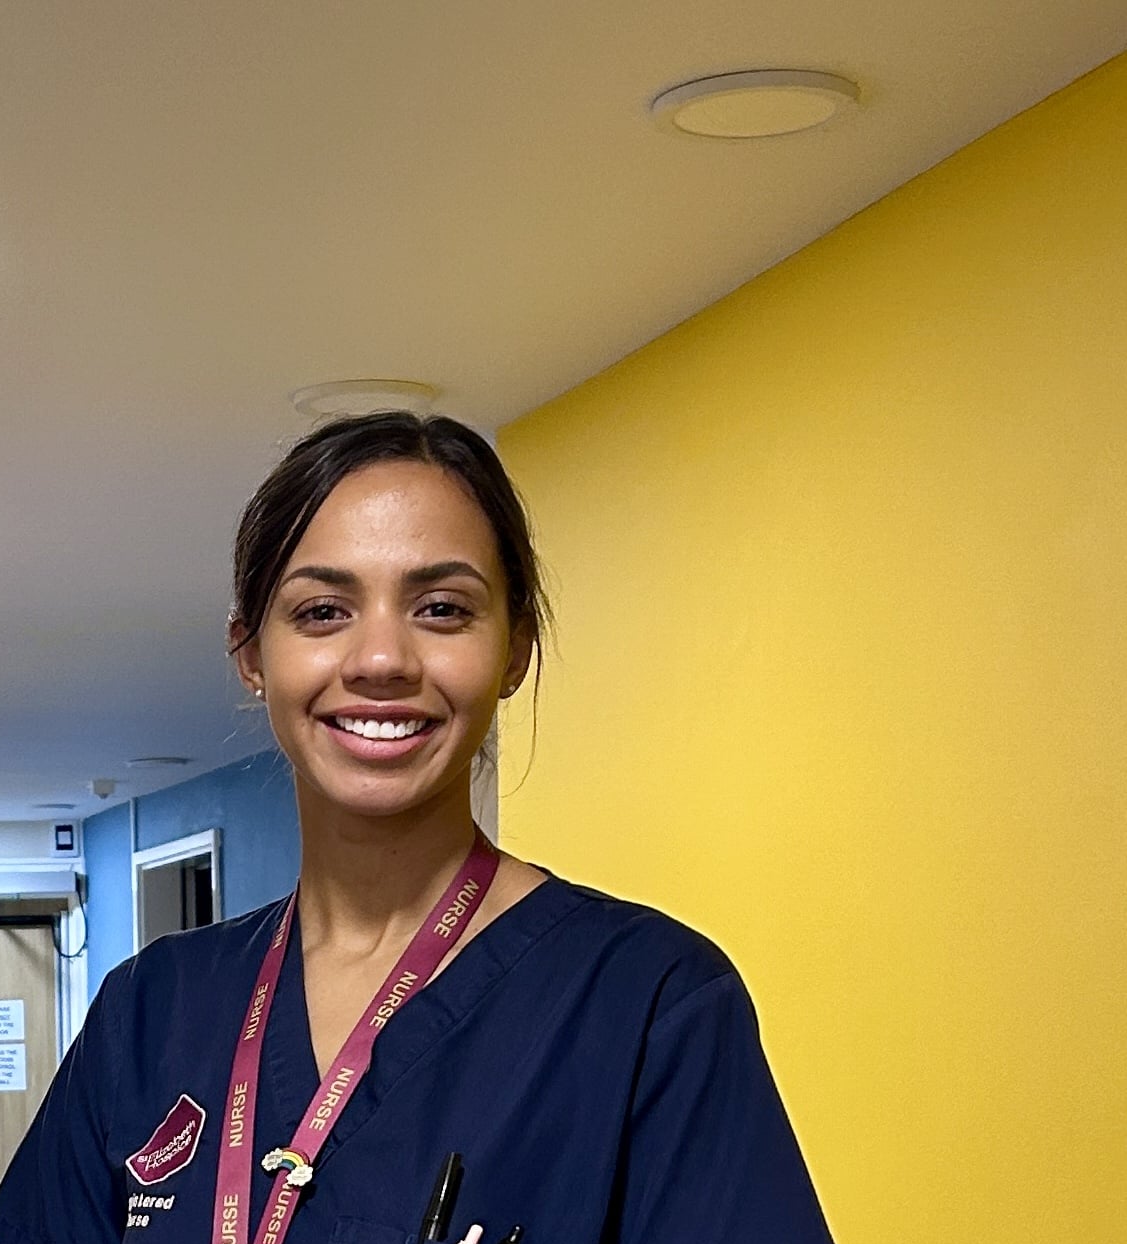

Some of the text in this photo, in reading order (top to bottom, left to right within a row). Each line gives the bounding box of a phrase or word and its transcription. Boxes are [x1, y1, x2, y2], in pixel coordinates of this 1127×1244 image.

[434, 878, 480, 939] NURSE
[244, 982, 269, 1041] NURSE
[369, 970, 418, 1030] NURSE
[229, 1081, 248, 1148] NURSE
[309, 1066, 355, 1132] NURSE
